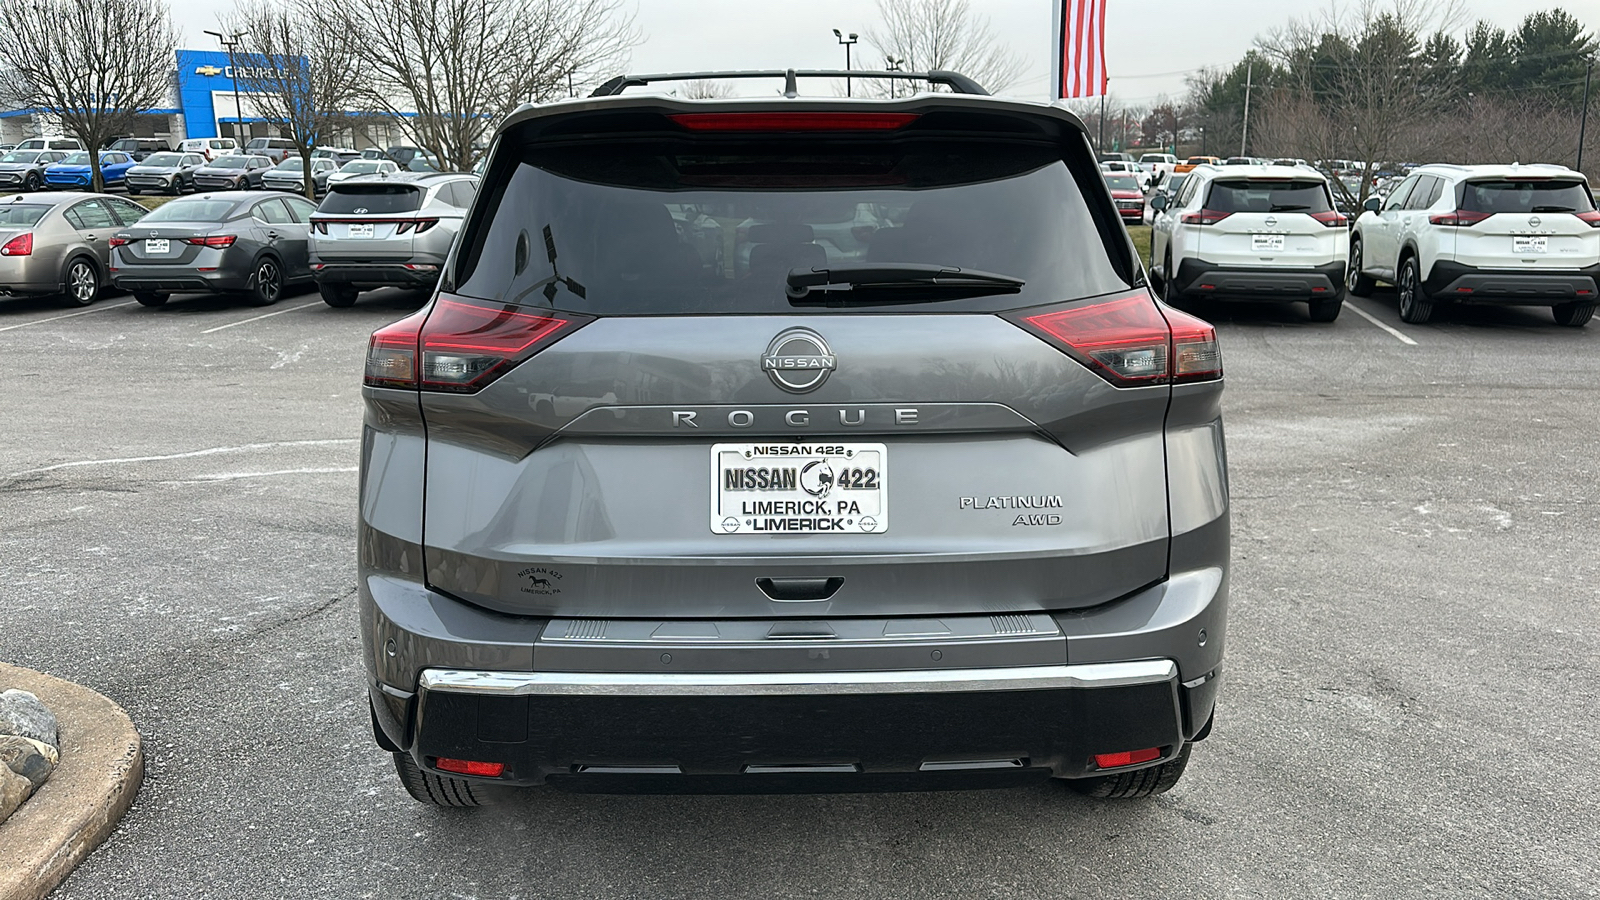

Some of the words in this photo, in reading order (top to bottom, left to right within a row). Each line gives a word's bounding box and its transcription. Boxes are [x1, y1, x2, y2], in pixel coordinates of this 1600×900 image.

[224, 65, 297, 80] CHEVROL
[765, 358, 834, 368] NISSAN
[672, 408, 919, 428] ROGUE
[753, 446, 812, 455] NISSAN
[815, 446, 845, 455] 422
[725, 468, 797, 490] NISSAN
[742, 501, 832, 516] LIMERICK,
[837, 501, 861, 514] PA
[959, 495, 1063, 509] PLATINUM
[753, 518, 845, 531] LIMERICK
[1012, 514, 1063, 526] AWD
[518, 568, 546, 578] NISSAN
[549, 570, 563, 580] 422
